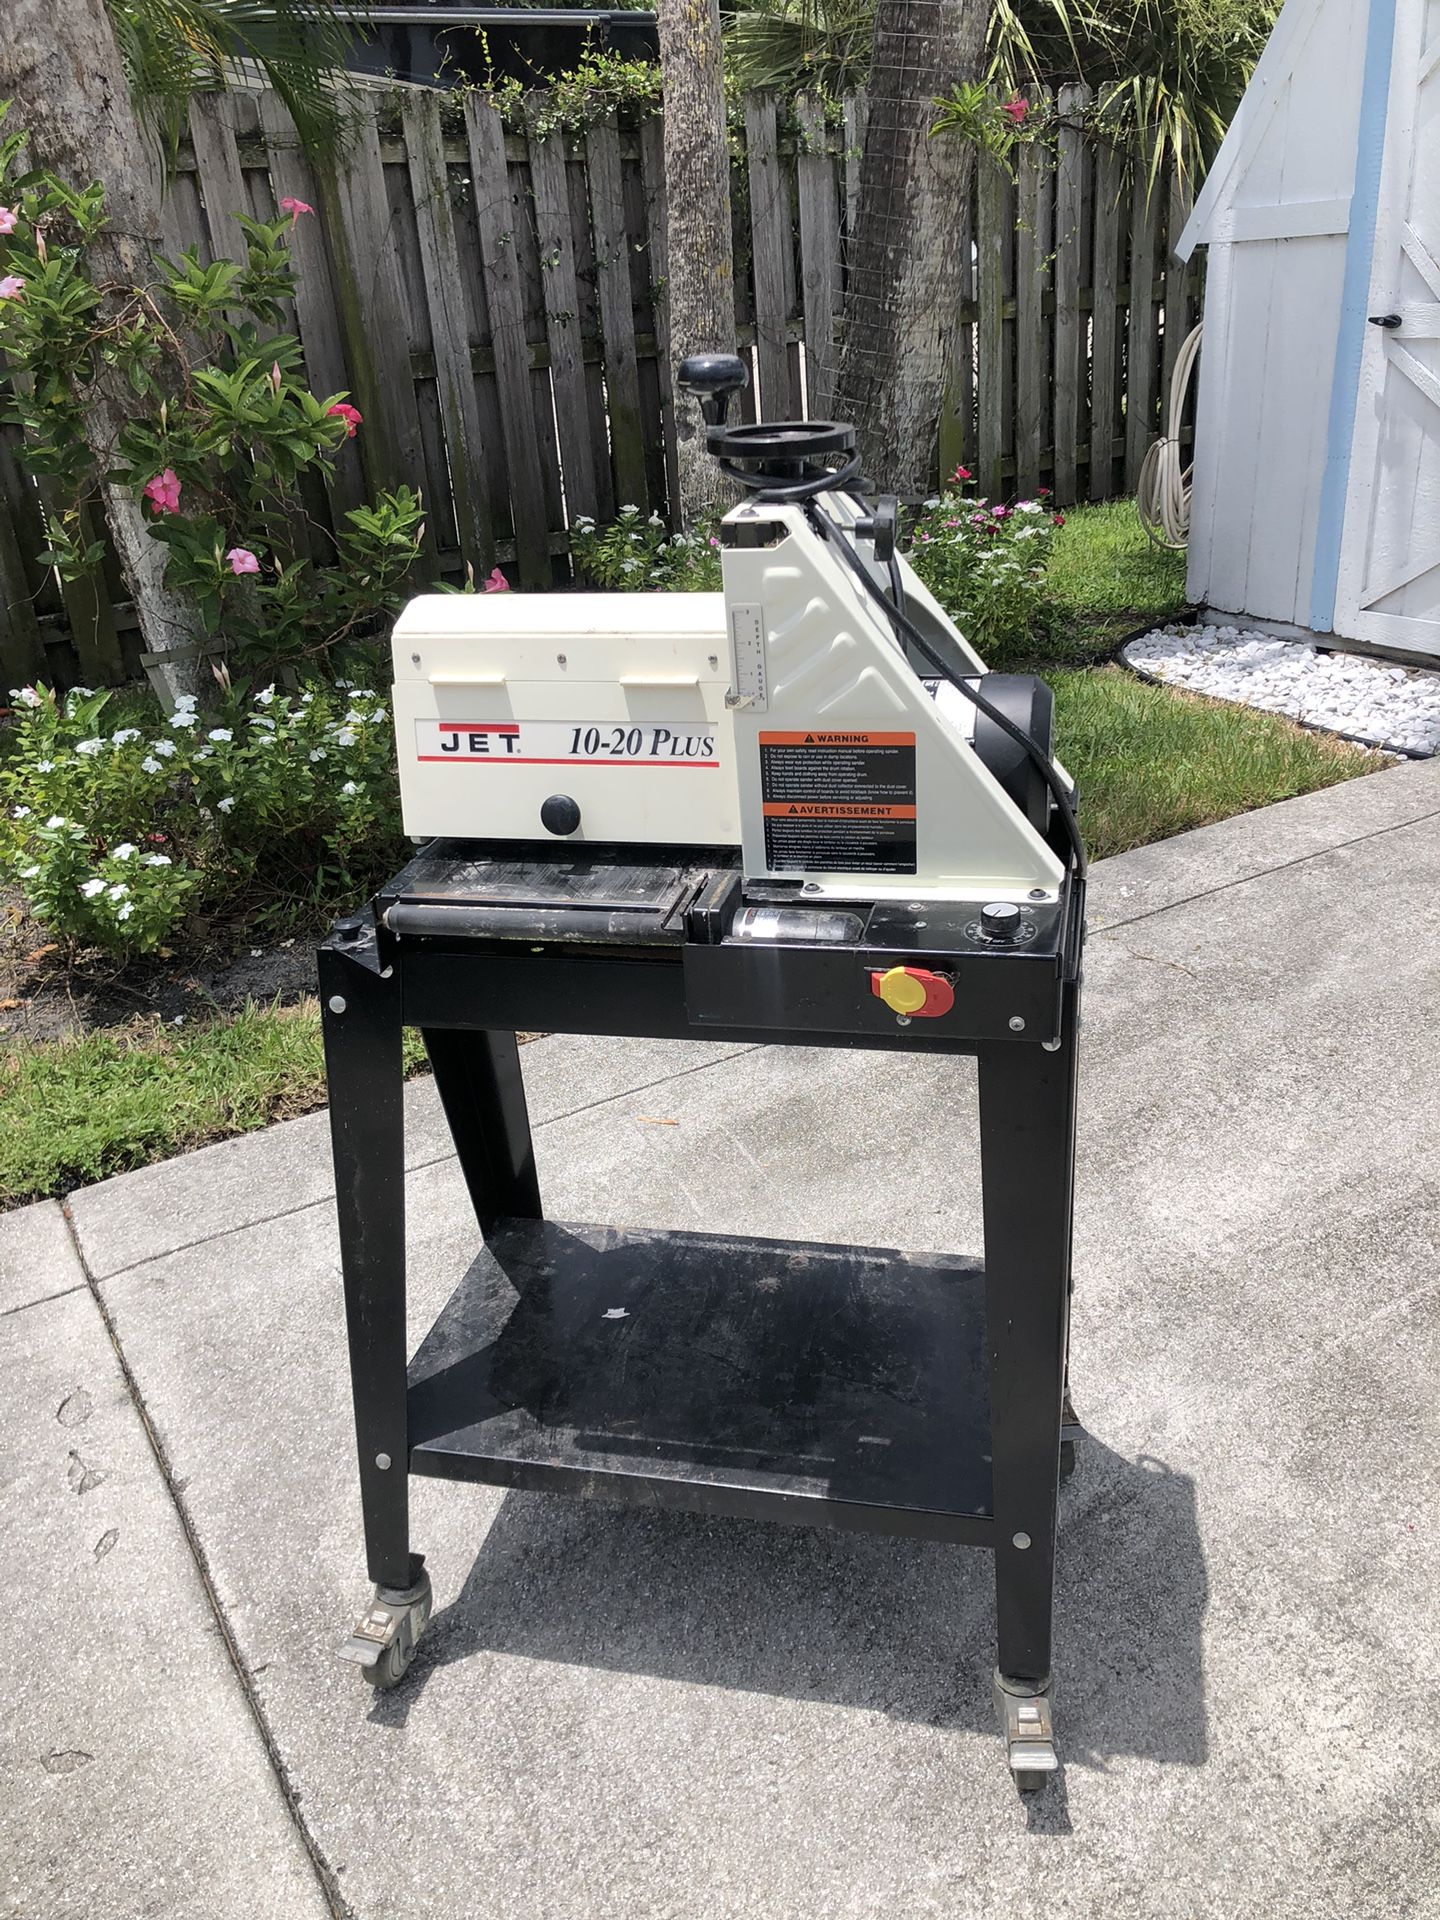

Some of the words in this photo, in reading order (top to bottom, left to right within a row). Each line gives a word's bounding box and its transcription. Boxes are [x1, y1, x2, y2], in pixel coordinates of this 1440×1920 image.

[440, 733, 520, 754] JET
[568, 727, 643, 755] 10-20
[818, 735, 869, 743] WARNING
[800, 806, 892, 815] AVERTISSEMENT
